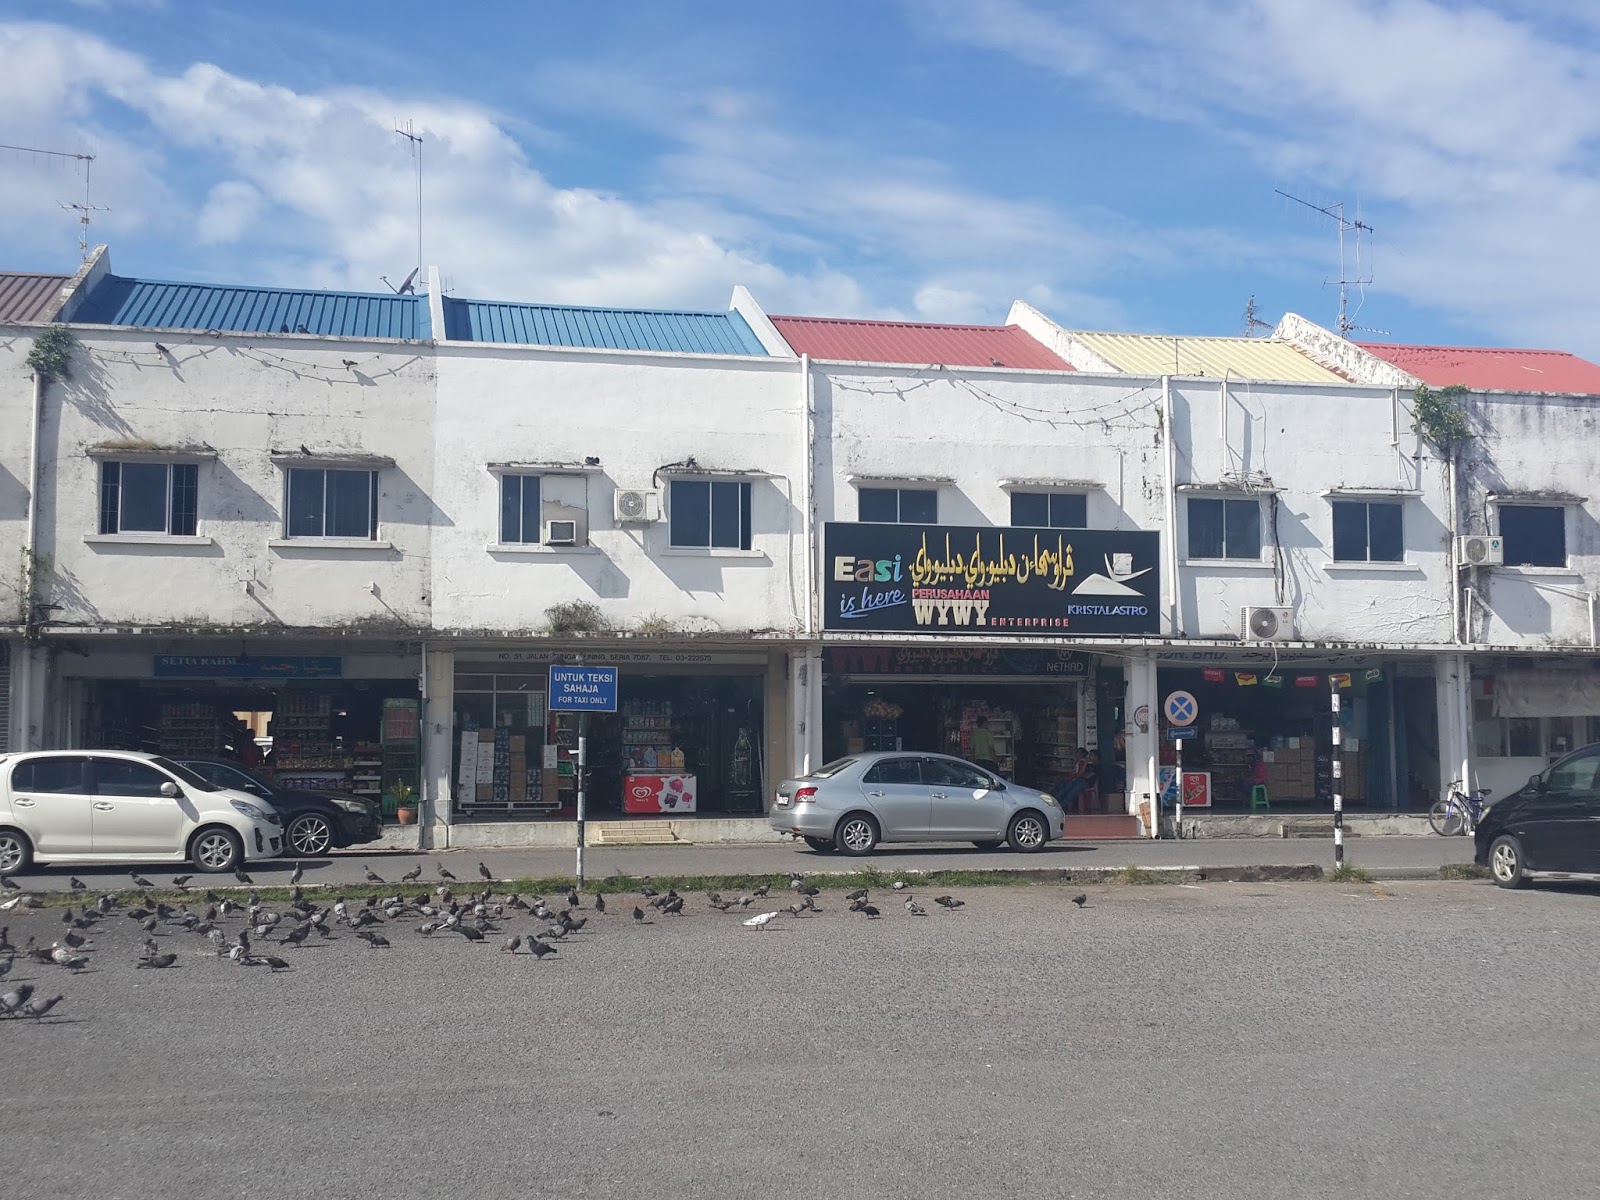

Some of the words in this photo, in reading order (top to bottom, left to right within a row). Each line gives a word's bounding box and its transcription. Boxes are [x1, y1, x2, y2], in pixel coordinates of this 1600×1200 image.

[834, 554, 903, 582] Easi
[840, 593, 856, 613] is
[861, 586, 906, 610] here
[912, 588, 990, 600] PERUSAHAAN
[912, 599, 990, 625] WYWY
[1067, 605, 1148, 616] KRISTALASTRO
[991, 617, 1069, 627] ENTERPRISE
[161, 656, 198, 665] SETIA
[610, 653, 630, 661] SERIA
[1046, 661, 1084, 673] NETKAD
[554, 672, 585, 682] UNTUK
[587, 673, 613, 683] TEKSI
[563, 683, 599, 693] SAHAJA
[574, 696, 589, 704] TAXI
